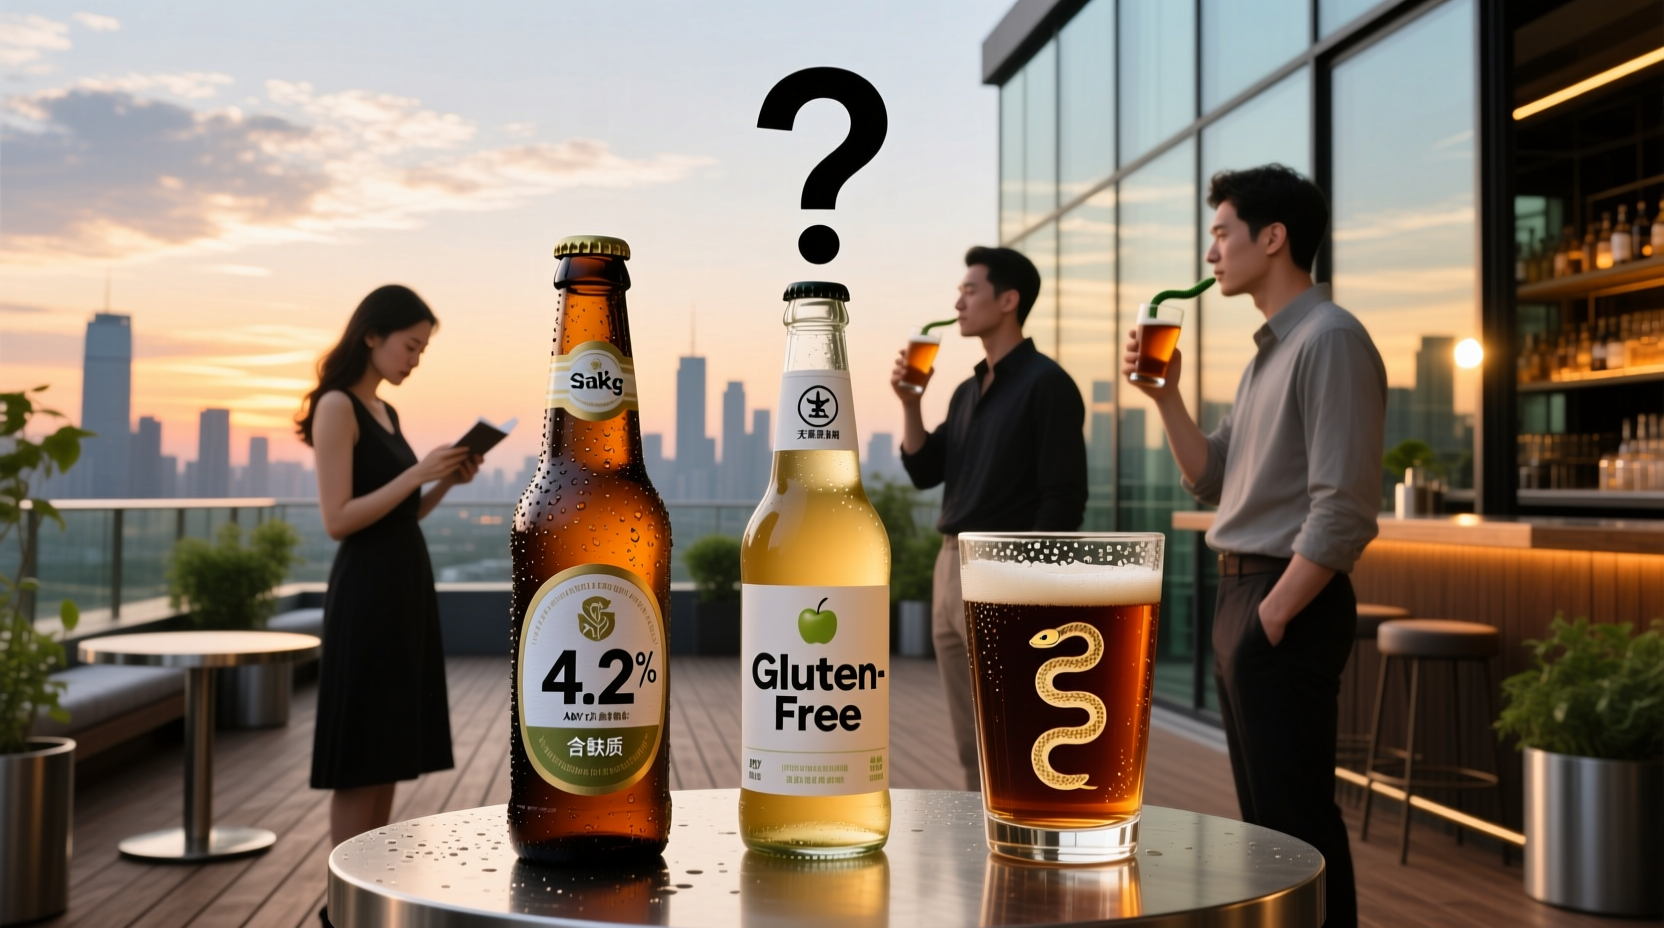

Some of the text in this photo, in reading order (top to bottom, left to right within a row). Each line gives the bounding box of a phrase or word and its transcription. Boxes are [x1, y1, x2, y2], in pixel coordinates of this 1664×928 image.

[541, 649, 657, 705] 4.2%
[752, 652, 885, 691] Gluten-
[775, 695, 862, 732] Free
